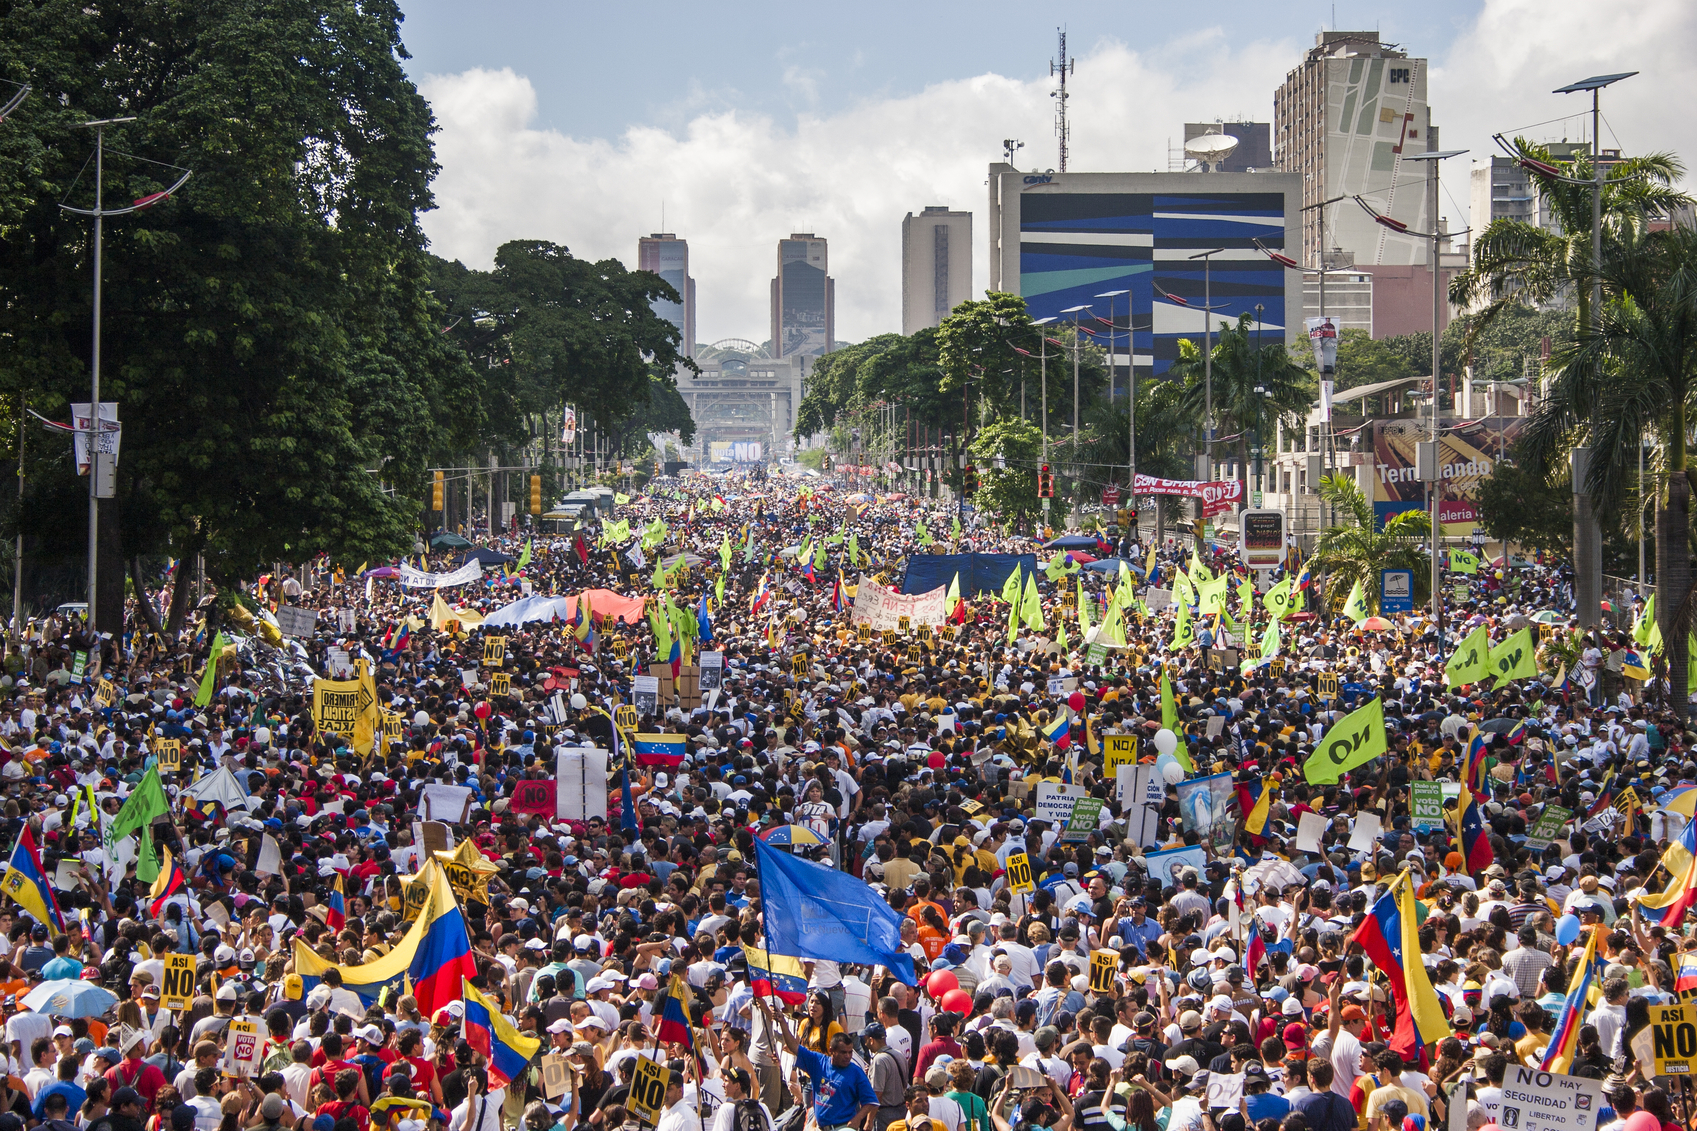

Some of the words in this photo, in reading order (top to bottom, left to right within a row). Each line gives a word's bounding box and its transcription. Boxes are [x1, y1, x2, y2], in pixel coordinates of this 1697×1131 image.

[1390, 68, 1410, 83] CPC
[1023, 174, 1052, 184] cantv
[713, 448, 734, 457] vota
[735, 443, 761, 462] NO
[1134, 474, 1159, 487] CON
[1437, 508, 1473, 521] alería
[1473, 534, 1486, 545] NO
[1455, 554, 1471, 565] NO
[665, 577, 675, 585] NO
[878, 577, 889, 586] NO
[1058, 582, 1067, 590] NO
[1063, 597, 1074, 606] NO
[1334, 601, 1346, 610] NO
[444, 625, 454, 633] NO
[603, 618, 613, 630] NO
[899, 620, 909, 630] NO
[858, 627, 870, 638] NO
[917, 629, 930, 640] NO
[941, 630, 954, 642] NO
[1540, 629, 1551, 638] NO
[883, 634, 895, 644] NO
[485, 644, 503, 659] NO
[615, 646, 626, 657] NO
[908, 650, 920, 662] NO
[1248, 649, 1262, 659] NO
[1087, 655, 1104, 665] NO
[793, 660, 806, 675] NO
[1269, 666, 1284, 678] NO
[492, 680, 509, 695] NO
[1319, 679, 1336, 693] NO
[98, 685, 112, 701] NO
[619, 711, 637, 727] NO
[384, 722, 401, 736] NO
[1113, 739, 1136, 754] NO!
[159, 747, 179, 764] NO
[524, 787, 546, 804] NO
[1046, 794, 1075, 802] PATRIA
[1414, 797, 1440, 805] vota
[1415, 805, 1441, 816] NO
[1074, 813, 1095, 821] vota
[1070, 819, 1093, 830] NO
[1541, 820, 1559, 829] vota
[1533, 827, 1556, 838] NO
[451, 868, 470, 885] NO
[1009, 863, 1030, 886] NO
[408, 886, 426, 905] NO
[171, 956, 188, 968] ASÍ
[1097, 954, 1113, 965] ASÍ
[162, 968, 194, 998] NO
[1090, 964, 1116, 990] NO
[1660, 1007, 1684, 1022] ASÍ
[235, 1023, 251, 1032] ASÍ
[237, 1034, 255, 1044] VOTA
[1653, 1022, 1697, 1059] NO
[238, 1046, 252, 1056] NO
[643, 1061, 661, 1079] ASÍ
[1665, 1065, 1690, 1073] JUSTICIA
[1517, 1067, 1553, 1089] NO
[1559, 1079, 1583, 1091] HAY
[631, 1069, 665, 1111] NO
[1504, 1089, 1567, 1111] SEGURIDAD
[1528, 1110, 1566, 1125] LIBERTAD
